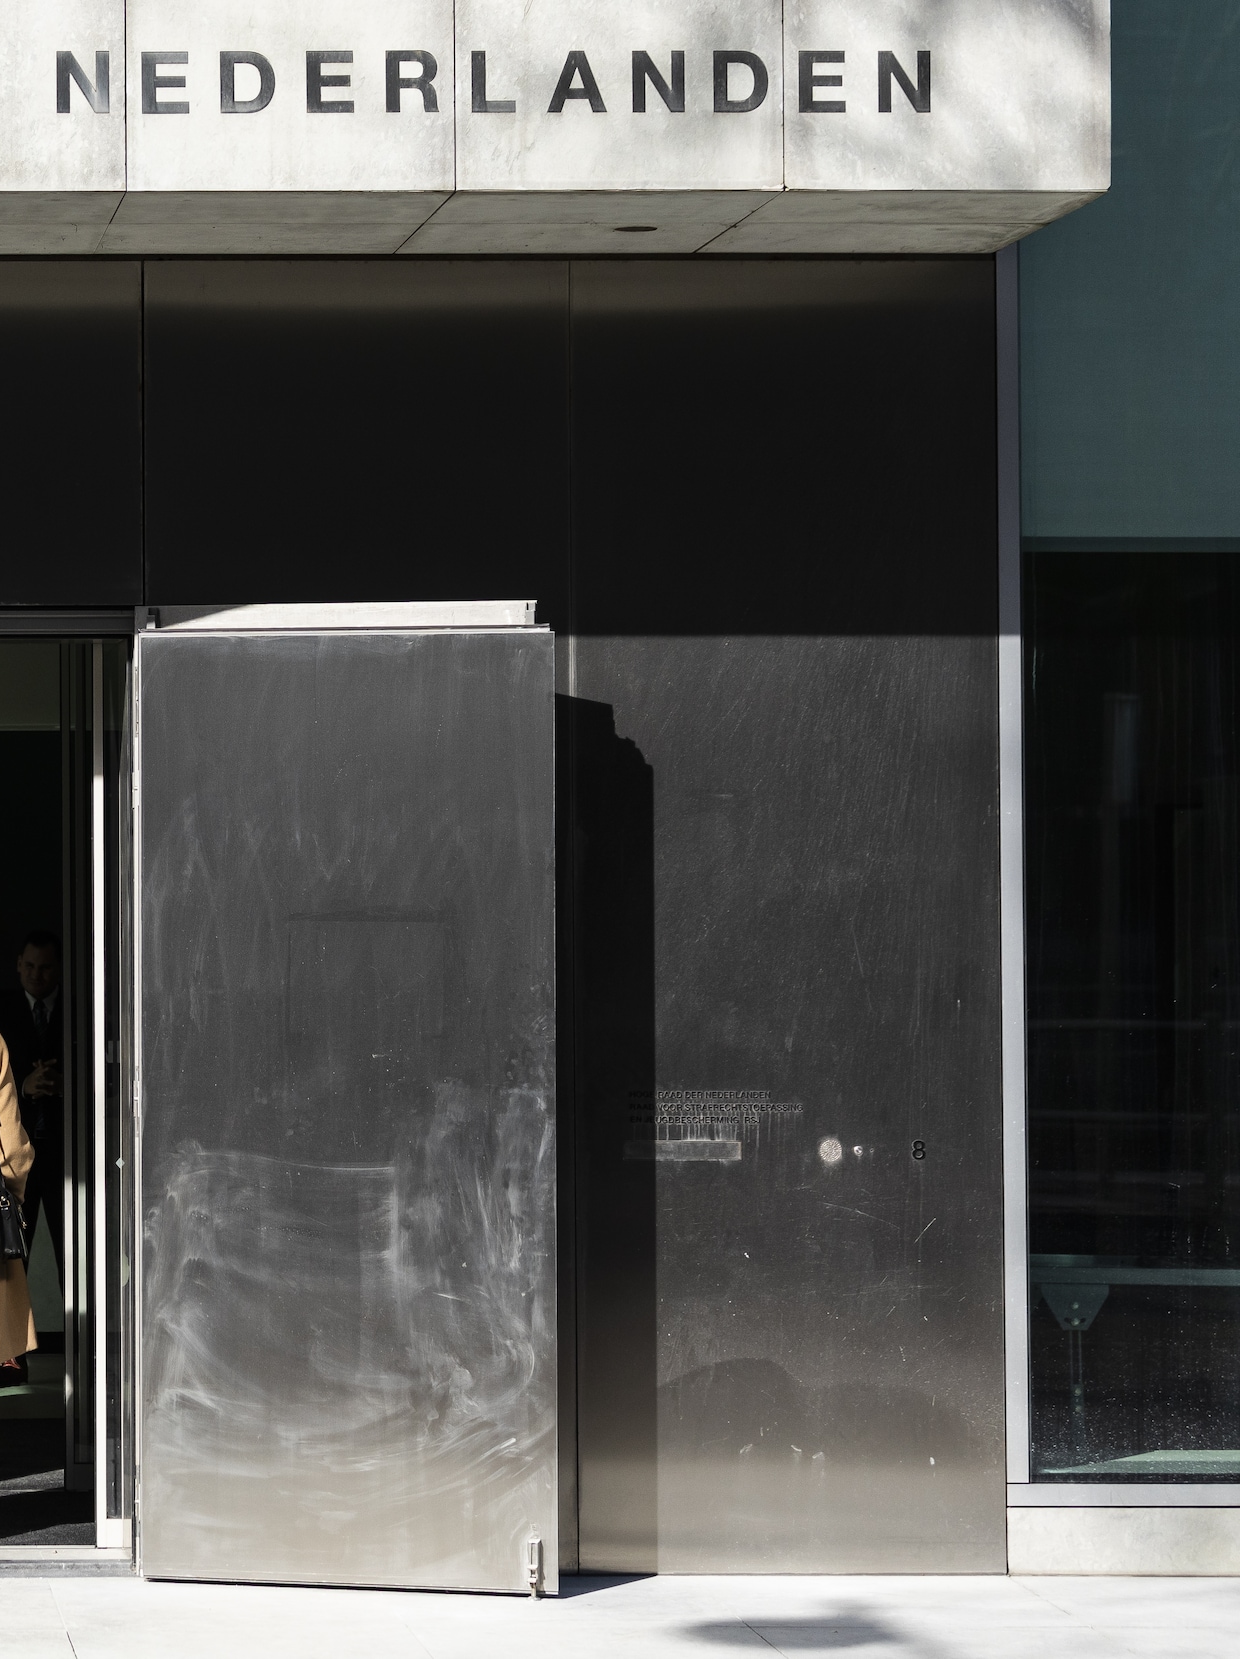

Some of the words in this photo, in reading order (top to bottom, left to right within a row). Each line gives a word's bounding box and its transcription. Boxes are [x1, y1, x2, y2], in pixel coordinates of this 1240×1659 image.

[55, 49, 932, 115] NEDERLANDEN
[628, 1090, 655, 1099] HOGE
[657, 1090, 683, 1099] RAAD
[684, 1090, 704, 1099] DER
[705, 1090, 772, 1099] NEDERLANDEN
[656, 1103, 684, 1112] VOOR
[684, 1103, 804, 1112] STRAFRECHTSTOEPASSING
[911, 1139, 926, 1160] 8
